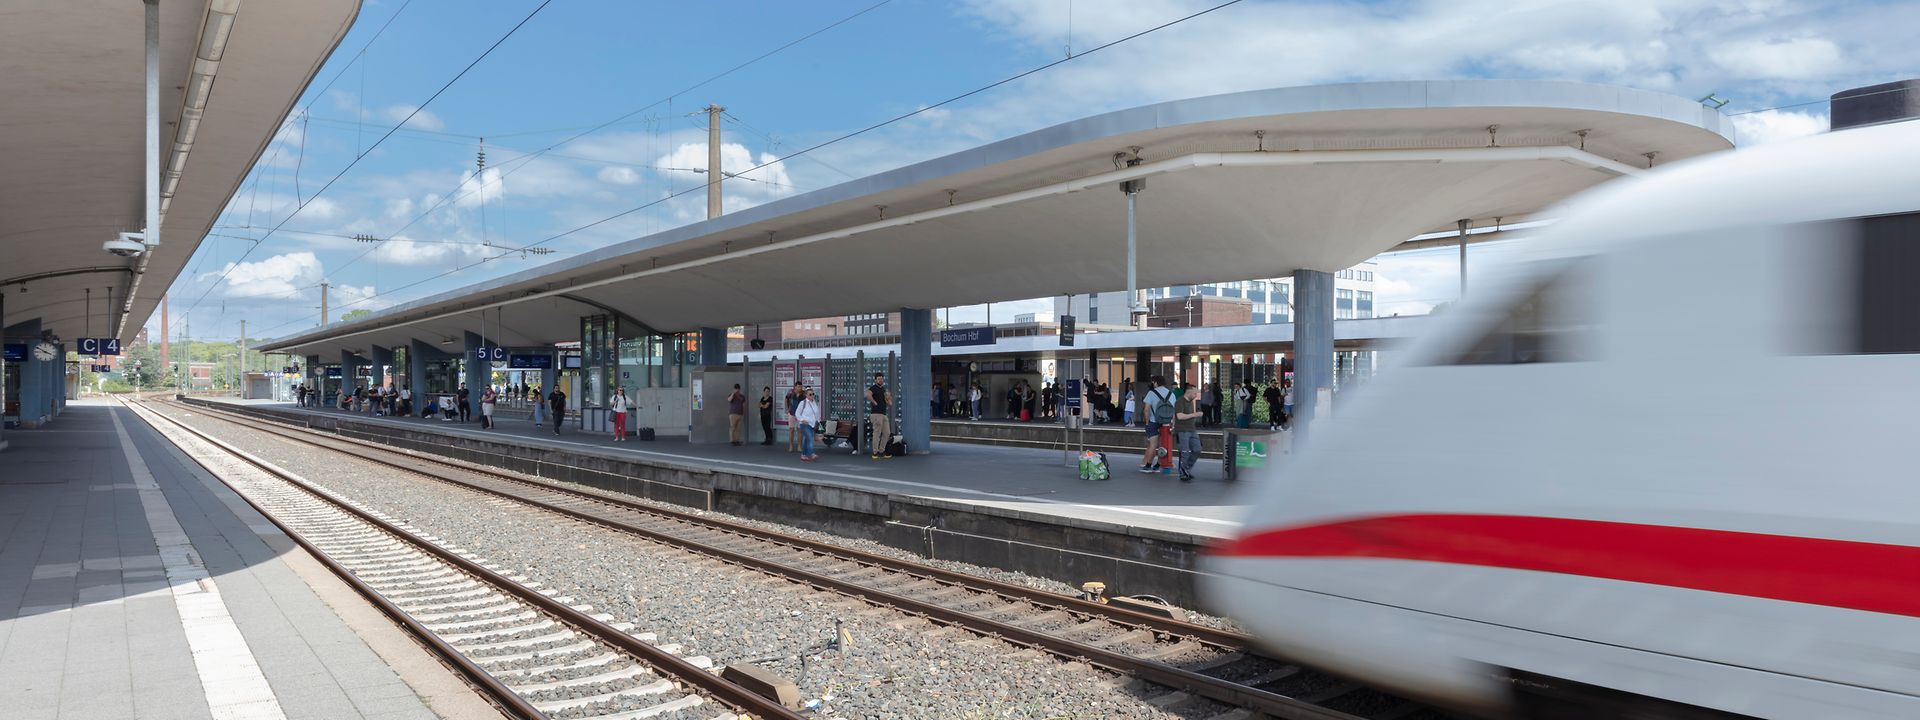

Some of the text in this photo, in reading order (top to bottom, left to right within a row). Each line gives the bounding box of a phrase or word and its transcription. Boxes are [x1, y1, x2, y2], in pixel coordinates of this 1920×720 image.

[943, 330, 979, 342] Bochum Hbf
[84, 339, 118, 352] C 4
[478, 348, 503, 359] 5 C
[689, 353, 696, 362] 6
